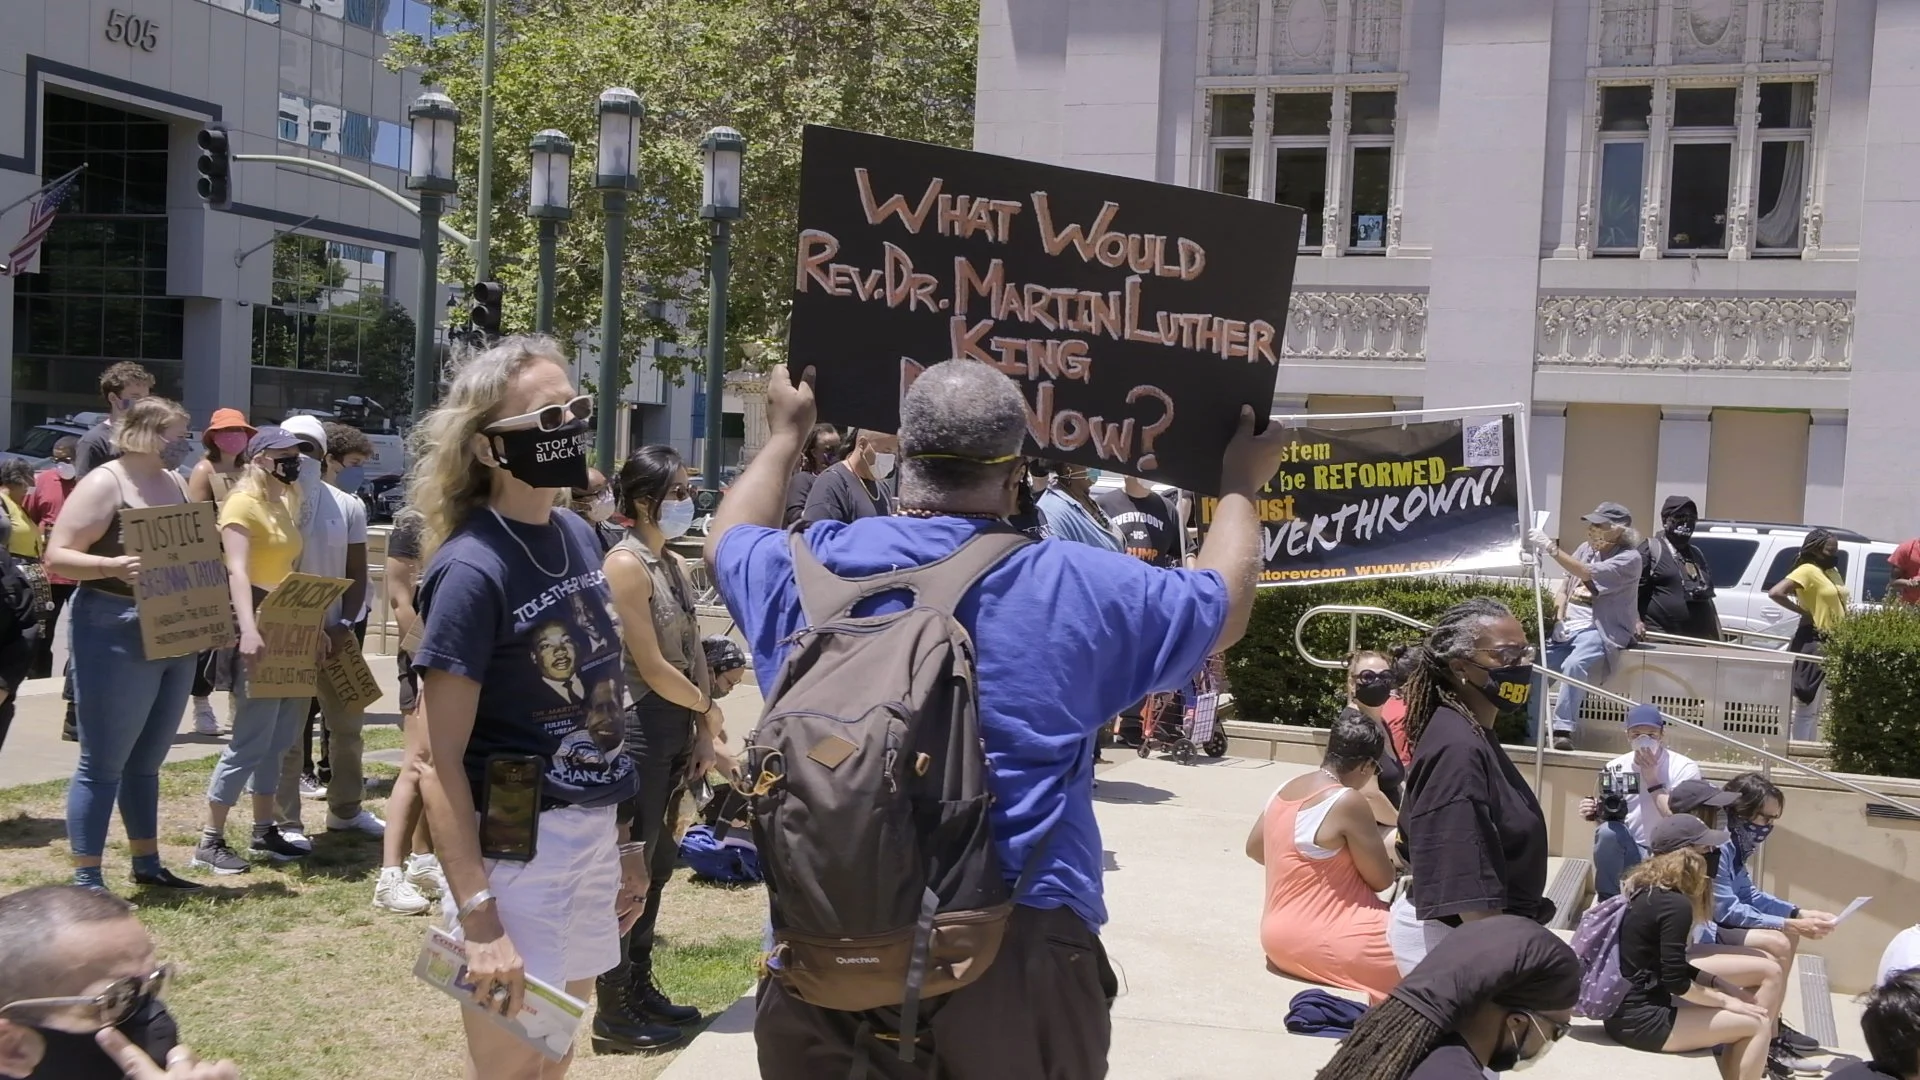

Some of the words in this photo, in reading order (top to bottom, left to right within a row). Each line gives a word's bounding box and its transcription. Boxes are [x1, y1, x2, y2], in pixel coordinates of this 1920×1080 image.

[104, 8, 160, 53] 505
[853, 167, 1022, 243] WHAT
[1031, 190, 1206, 281] WOULD
[954, 255, 1121, 341] MARTIN
[1124, 274, 1278, 367] LUTHER
[950, 315, 1092, 385] KING
[536, 438, 568, 453] STOP
[536, 447, 576, 463] BLACK
[1281, 440, 1331, 463] stem
[1280, 471, 1306, 493] be
[1112, 511, 1164, 531] EVERYBODY
[1256, 495, 1296, 522] ust
[1262, 466, 1504, 562] VERTHROWN!
[130, 511, 204, 552] JUSTICE
[1125, 546, 1159, 562] RUMP
[513, 576, 581, 622] TOGETHER
[835, 956, 880, 965] Quechua
